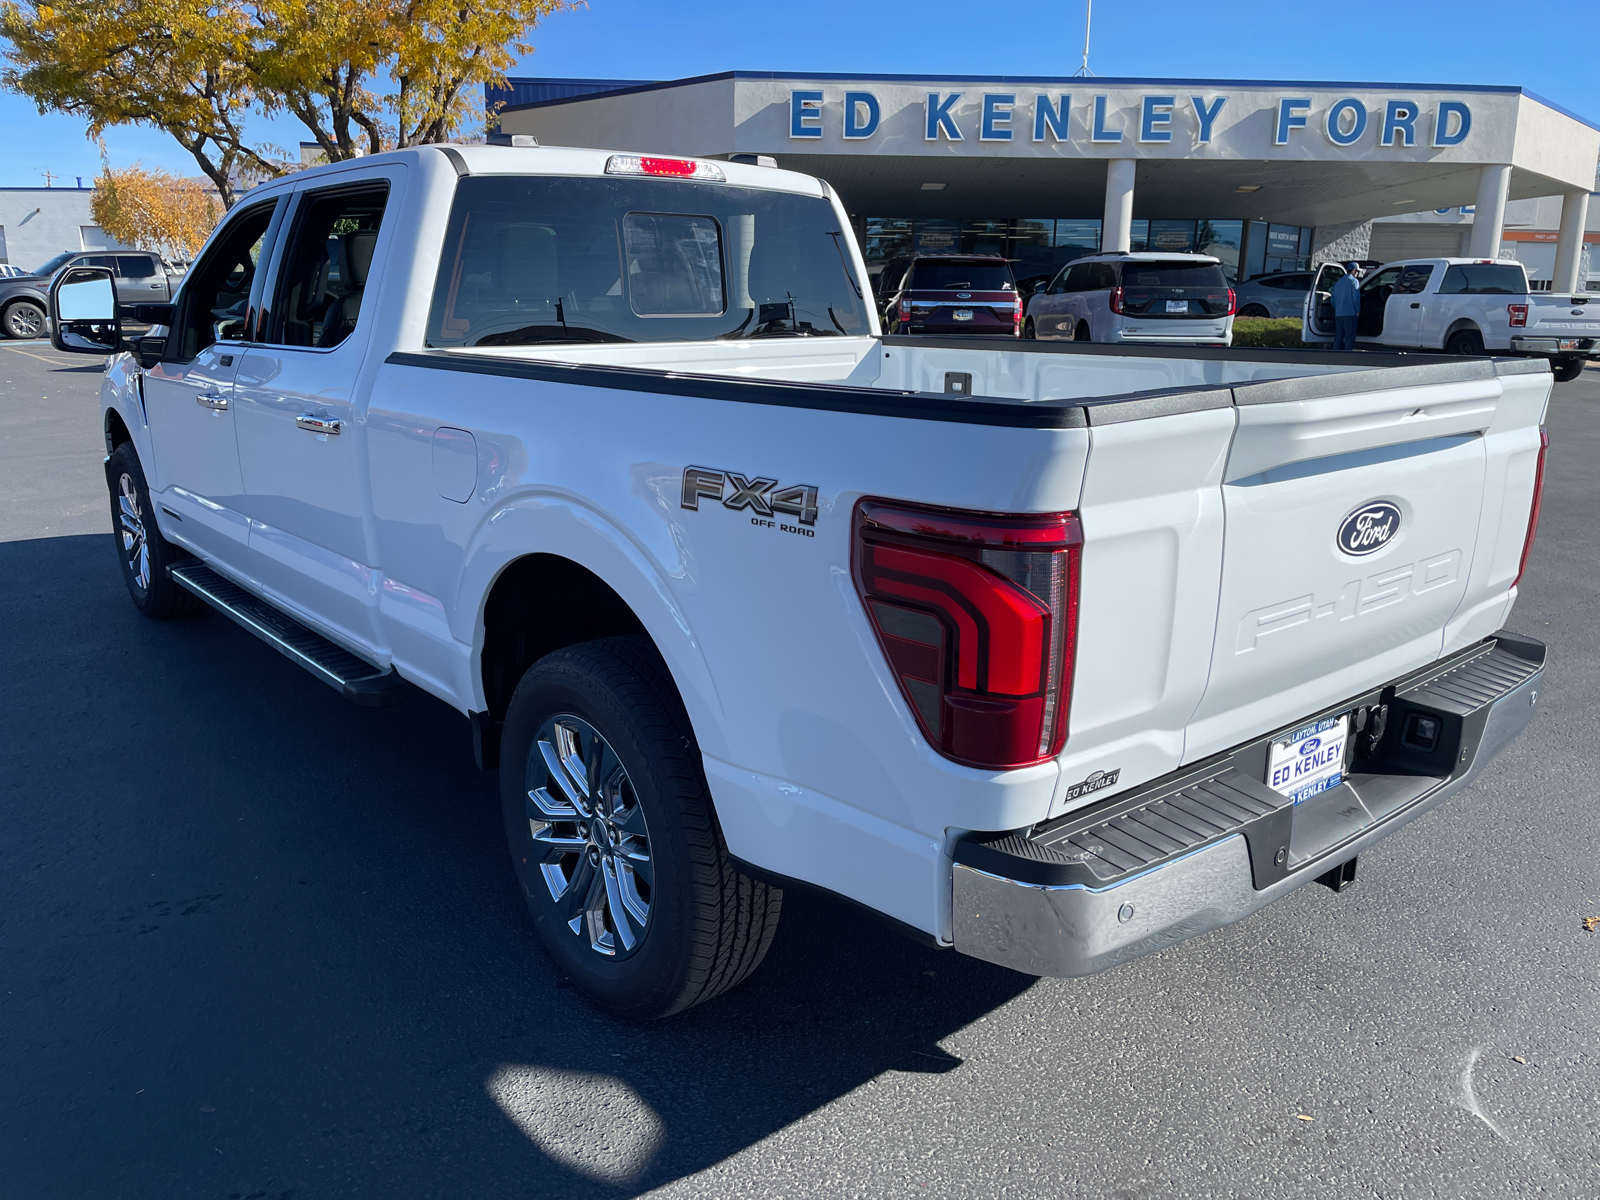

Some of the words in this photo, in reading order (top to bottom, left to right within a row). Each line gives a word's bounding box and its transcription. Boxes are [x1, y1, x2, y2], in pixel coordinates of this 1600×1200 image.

[789, 89, 881, 140] ED
[924, 92, 1229, 144] KENLEY
[1273, 97, 1472, 147] FORD
[681, 464, 819, 526] FX4
[751, 517, 776, 528] OFF
[780, 523, 815, 538] ROAD
[1350, 510, 1393, 548] Ford
[1235, 548, 1462, 655] F-150
[1318, 717, 1335, 732] UTAH
[1302, 740, 1318, 754] Ford
[1272, 765, 1290, 786] ED
[1294, 742, 1342, 777] KENLEY
[1081, 773, 1119, 795] KENLEY
[1297, 778, 1329, 803] KENLEY
